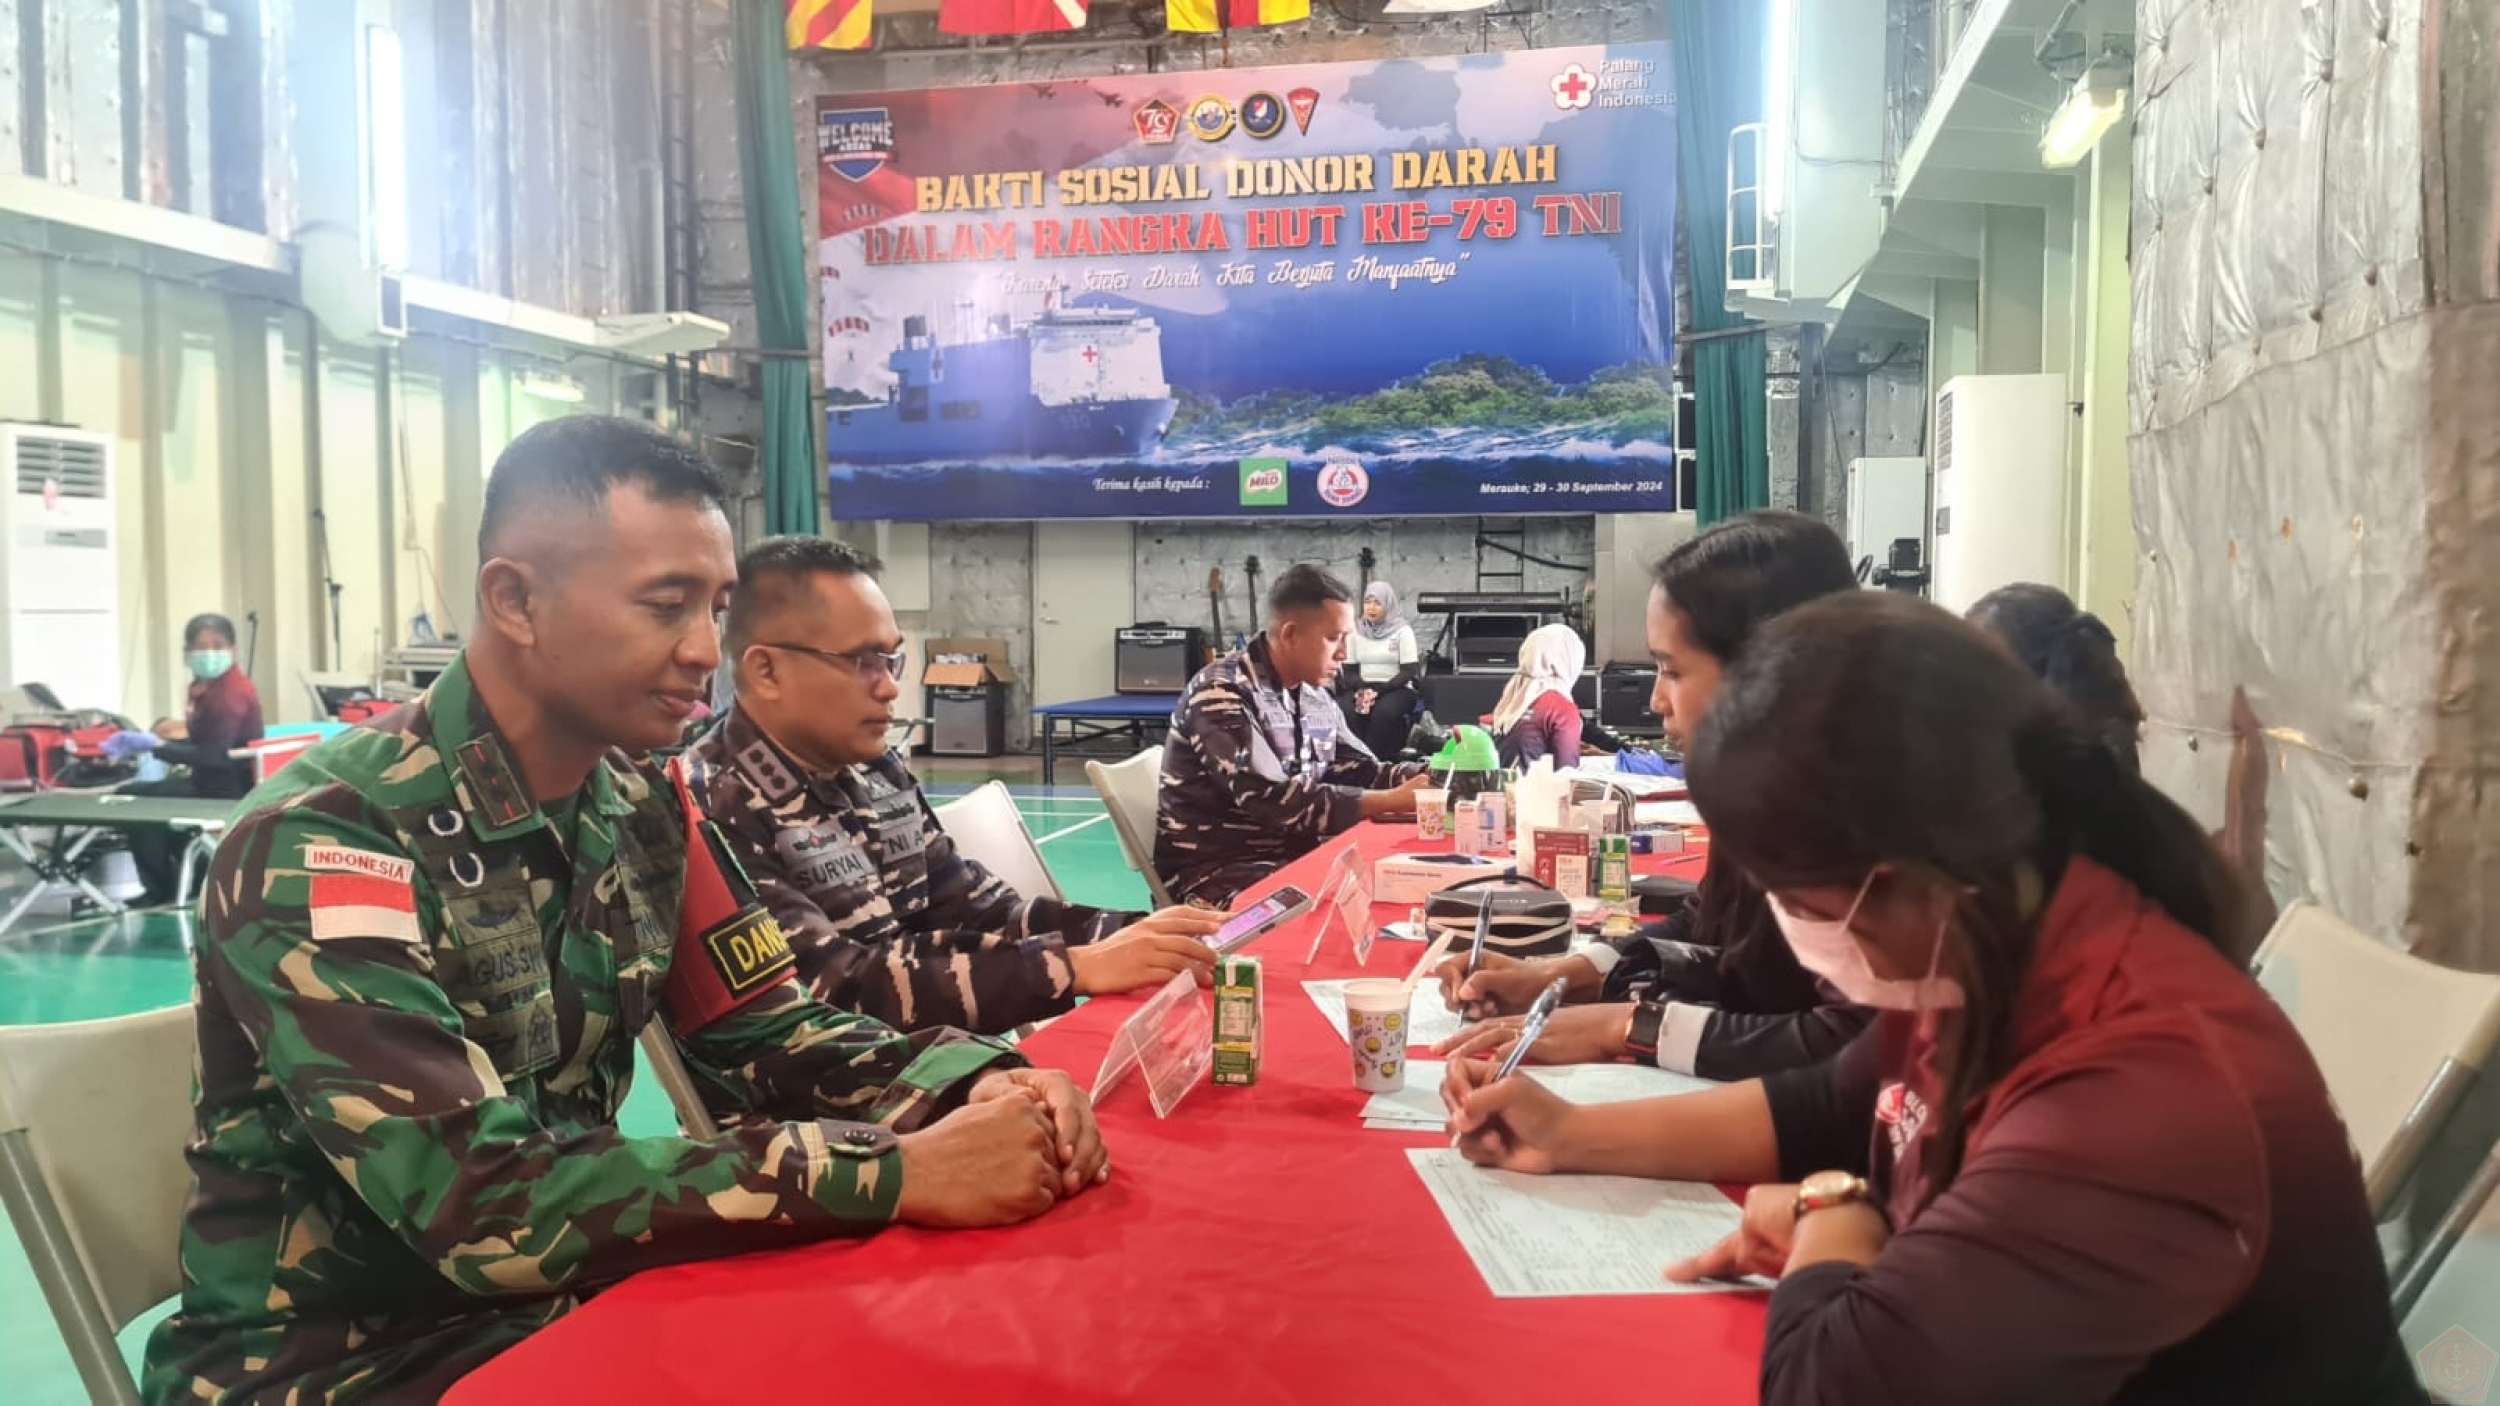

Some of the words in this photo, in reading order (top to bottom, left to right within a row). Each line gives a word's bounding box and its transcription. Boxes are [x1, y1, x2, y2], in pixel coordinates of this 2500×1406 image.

[1600, 58, 1655, 75] Palang
[1600, 74, 1649, 91] Merah
[1600, 91, 1676, 108] Indonesia
[818, 121, 894, 150] WELCOME
[915, 171, 1044, 212] BAKTI
[1058, 164, 1211, 205] SOSIAL
[1226, 154, 1375, 199] DONOR
[1391, 144, 1558, 190] DARAH
[864, 221, 1016, 265] DALAM
[1033, 212, 1231, 259] RANGKA
[1246, 204, 1345, 250] HUT
[1362, 198, 1517, 244] KE-79
[1533, 192, 1623, 236] TNI
[1143, 263, 1201, 289] Darah
[1217, 261, 1255, 287] Kita
[1092, 477, 1130, 491] Terima
[1132, 475, 1162, 493] kasih
[1164, 475, 1203, 493] kepada
[1249, 473, 1280, 488] MILO
[1533, 482, 1546, 493] 29
[1555, 481, 1570, 493] 30
[1572, 480, 1634, 495] September
[1635, 480, 1664, 492] 2024
[313, 850, 405, 880] INDONESIA
